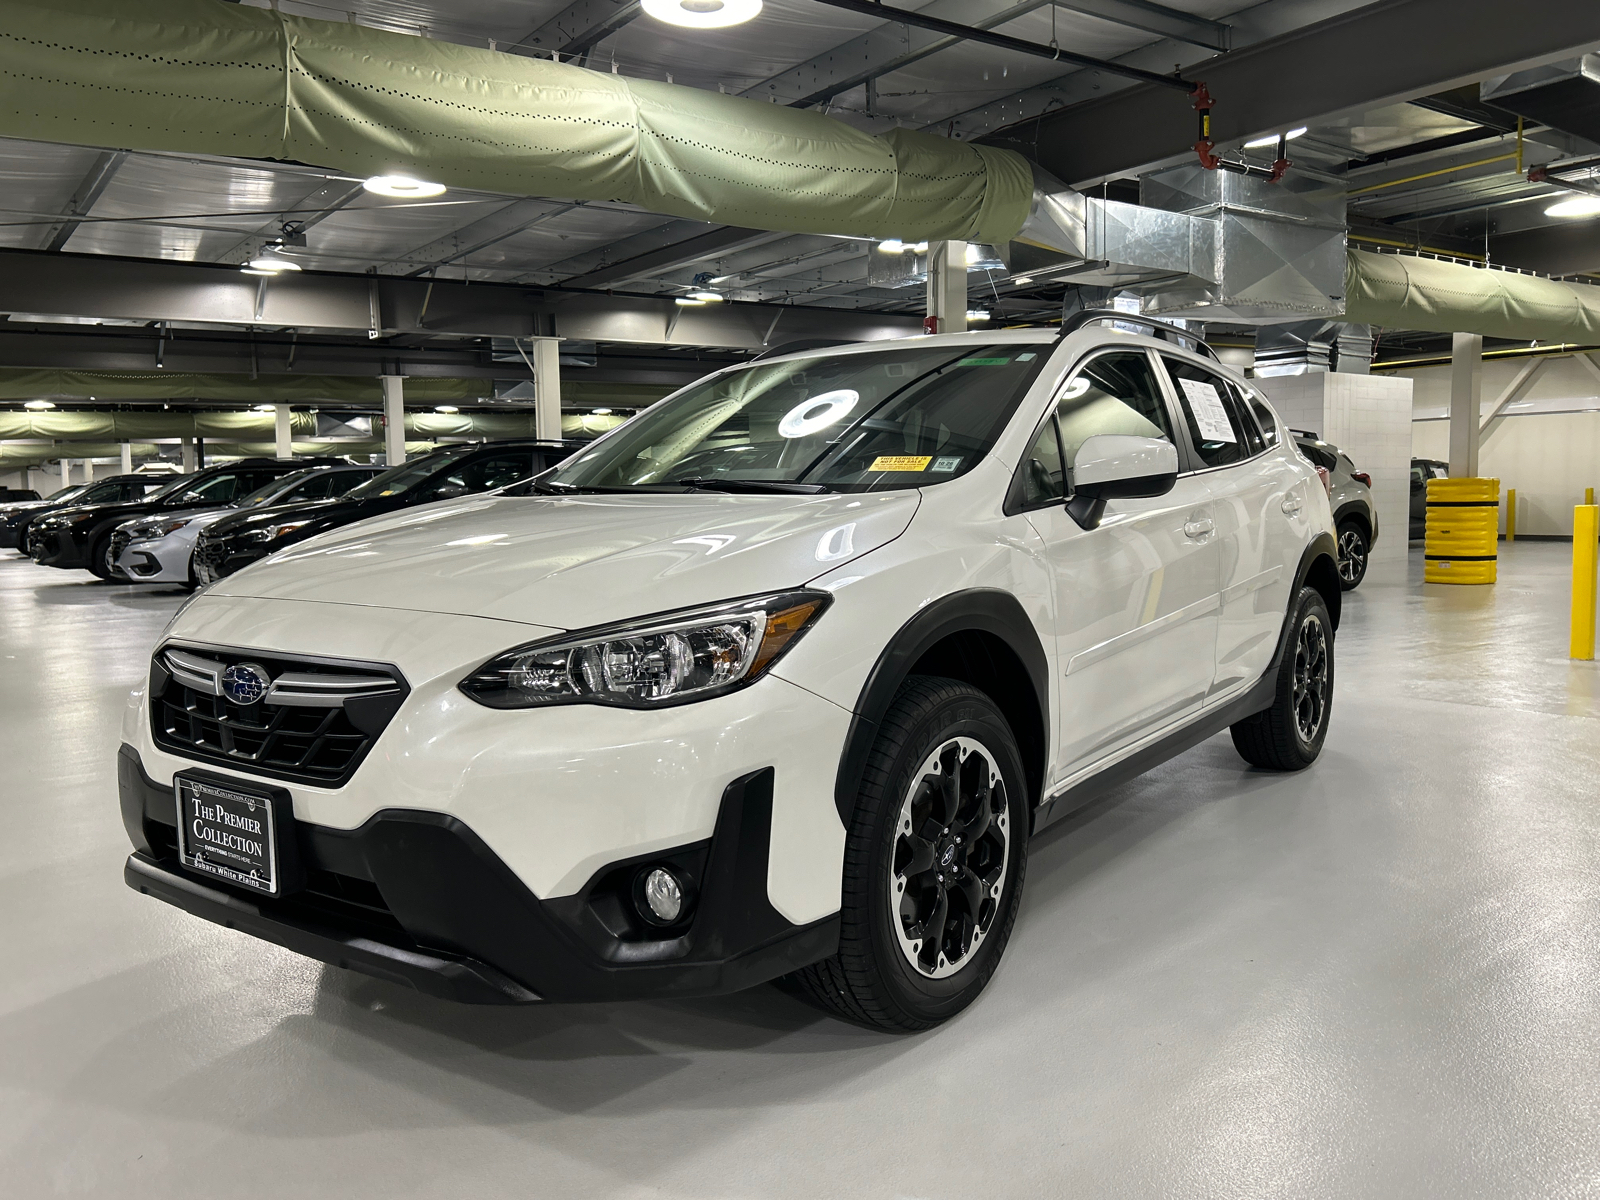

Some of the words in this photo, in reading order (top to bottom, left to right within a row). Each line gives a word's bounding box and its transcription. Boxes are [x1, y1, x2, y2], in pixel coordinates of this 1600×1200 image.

[191, 798, 215, 822] THE
[215, 804, 262, 835] PREMIER
[193, 818, 263, 858] COLLECTION
[204, 844, 228, 857] EVERYTHING
[227, 851, 241, 861] STARTS
[193, 860, 216, 874] Subaru
[217, 867, 237, 880] White
[238, 873, 261, 889] Plains
